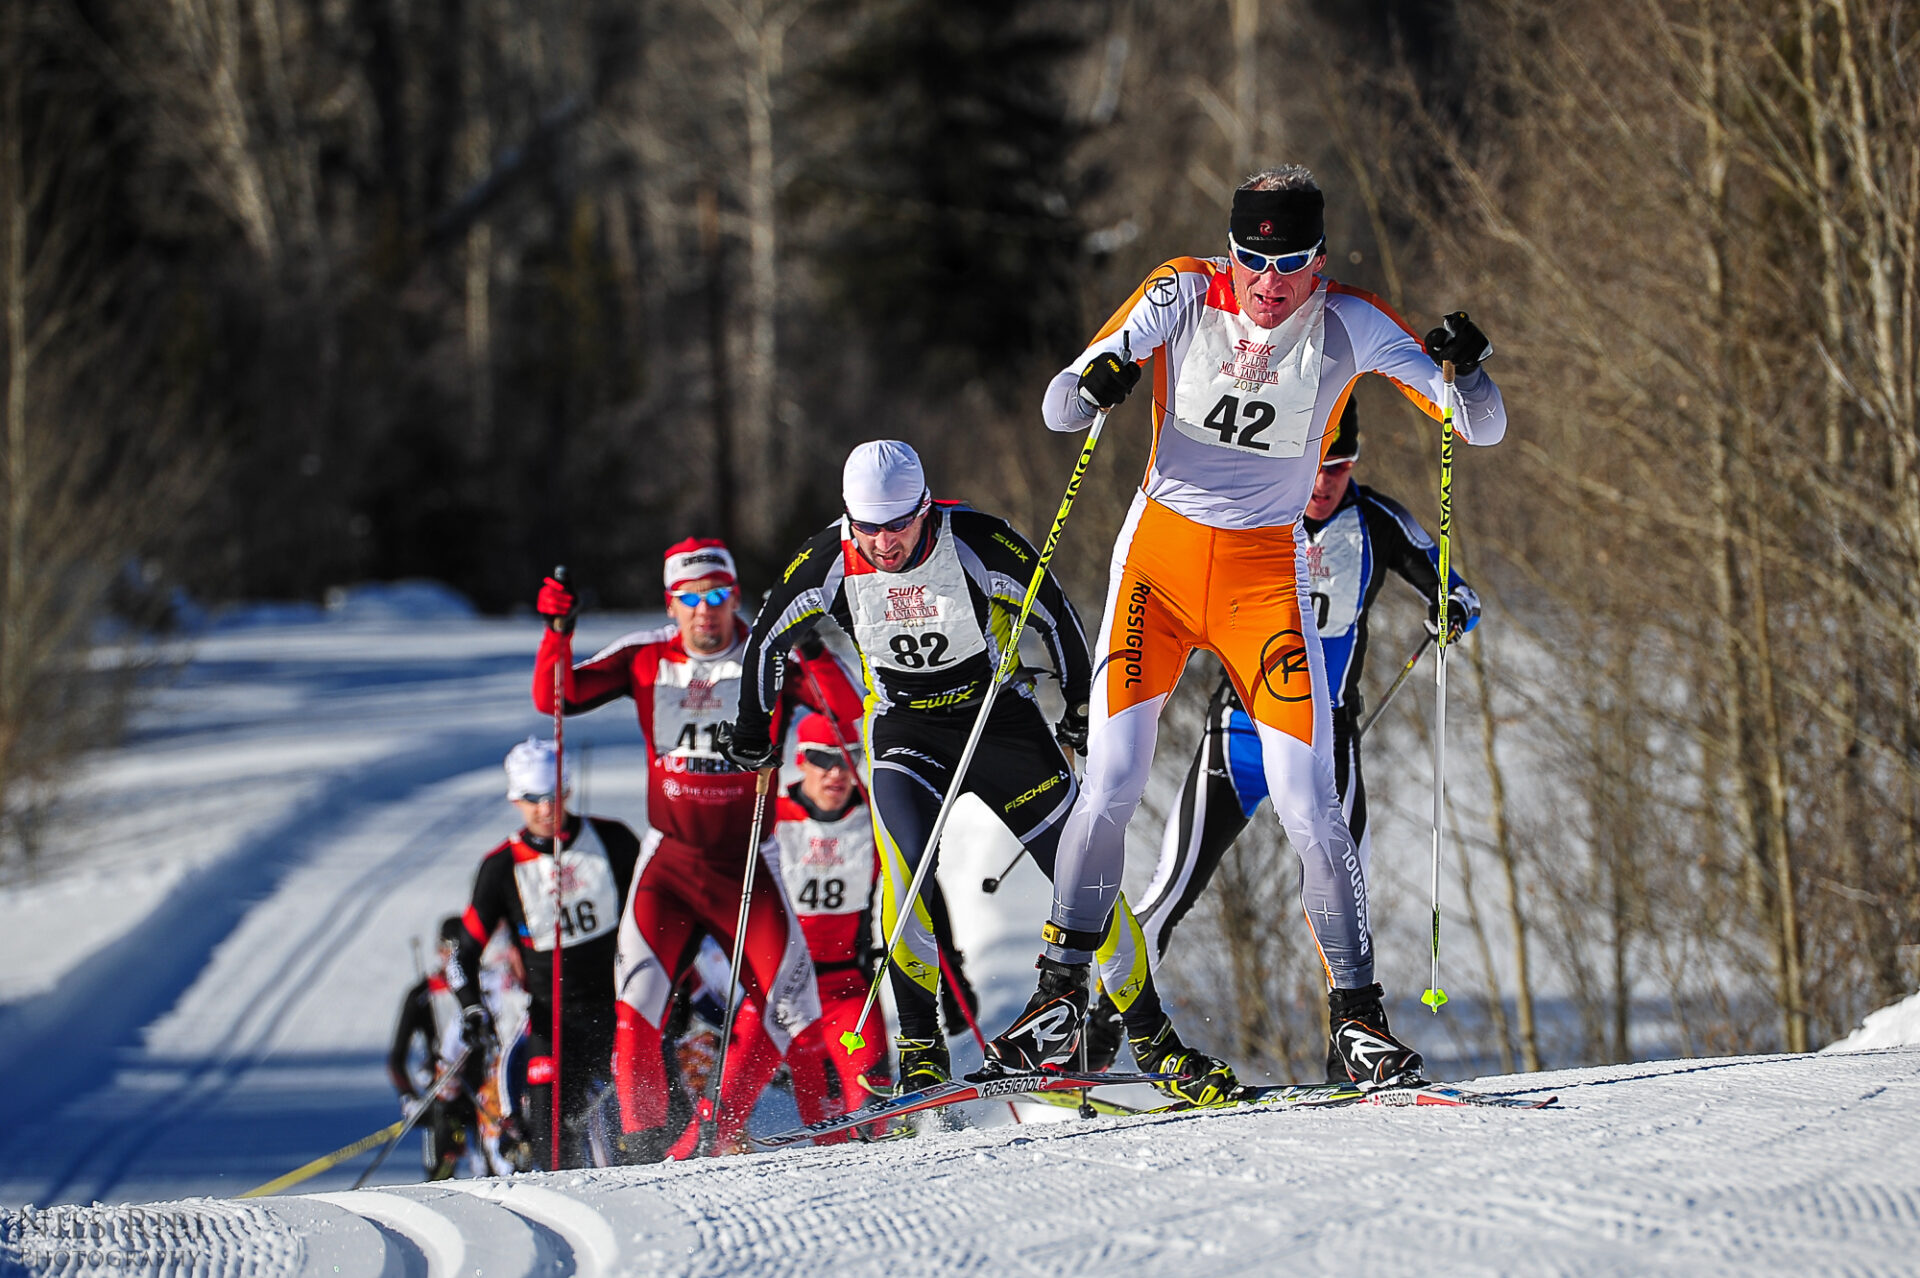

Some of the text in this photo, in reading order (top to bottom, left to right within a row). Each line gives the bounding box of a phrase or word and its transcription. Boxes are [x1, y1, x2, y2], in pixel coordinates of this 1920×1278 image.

[1203, 394, 1276, 451] 42
[889, 632, 957, 669] 82
[1125, 581, 1151, 689] ROSSIGNOL
[678, 723, 718, 752] 41
[1004, 775, 1060, 813] FISCHER
[799, 879, 844, 909] 48
[1342, 842, 1369, 956] ROSSIGNOL
[561, 900, 597, 936] 46
[981, 1077, 1039, 1097] ROSSIGNOL
